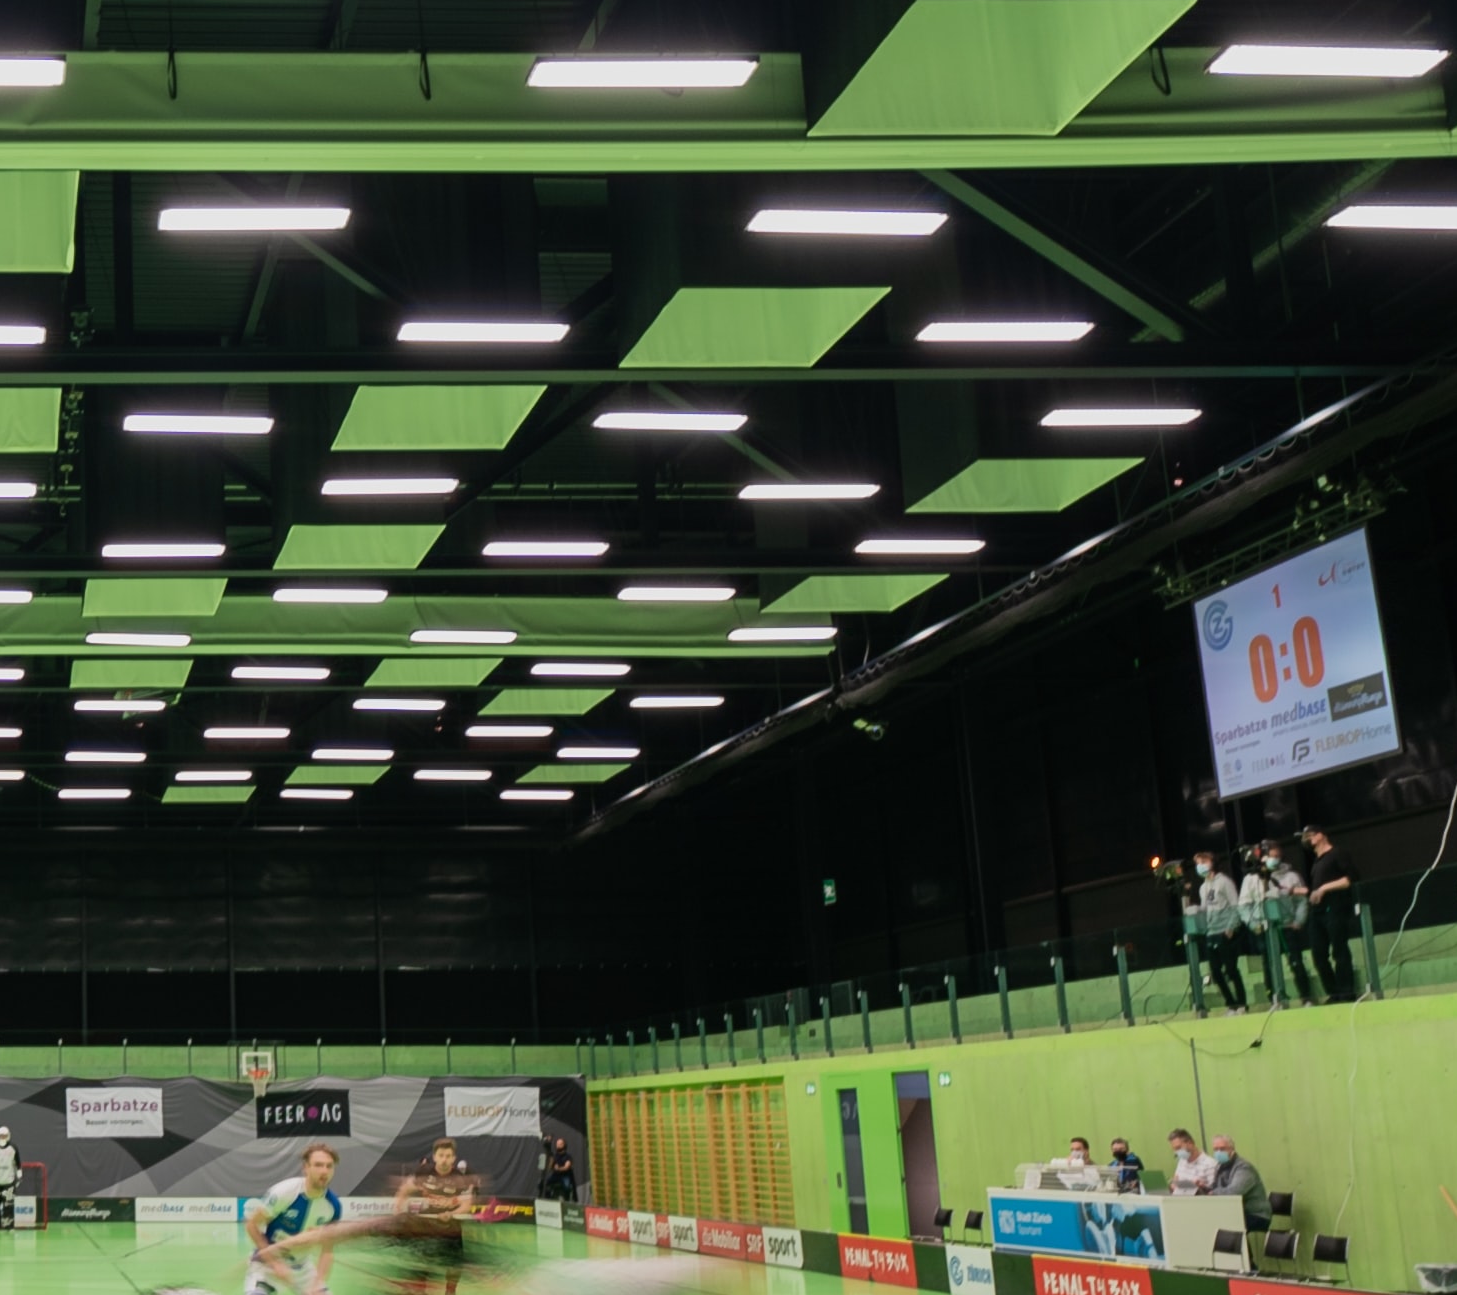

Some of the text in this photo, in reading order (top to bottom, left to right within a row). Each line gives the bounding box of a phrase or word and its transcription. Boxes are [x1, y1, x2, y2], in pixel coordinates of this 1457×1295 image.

[1272, 584, 1281, 608] 1
[1249, 615, 1325, 703] 0:0
[1214, 718, 1267, 746] Sparbatze
[70, 1098, 158, 1115] Sparbatze
[264, 1104, 341, 1125] FEER AG
[447, 1105, 537, 1118] FLEUROPHome
[632, 1219, 654, 1242] sport
[673, 1223, 695, 1246] sport
[746, 1233, 798, 1261] SRF sport
[844, 1247, 885, 1274] PENALTY
